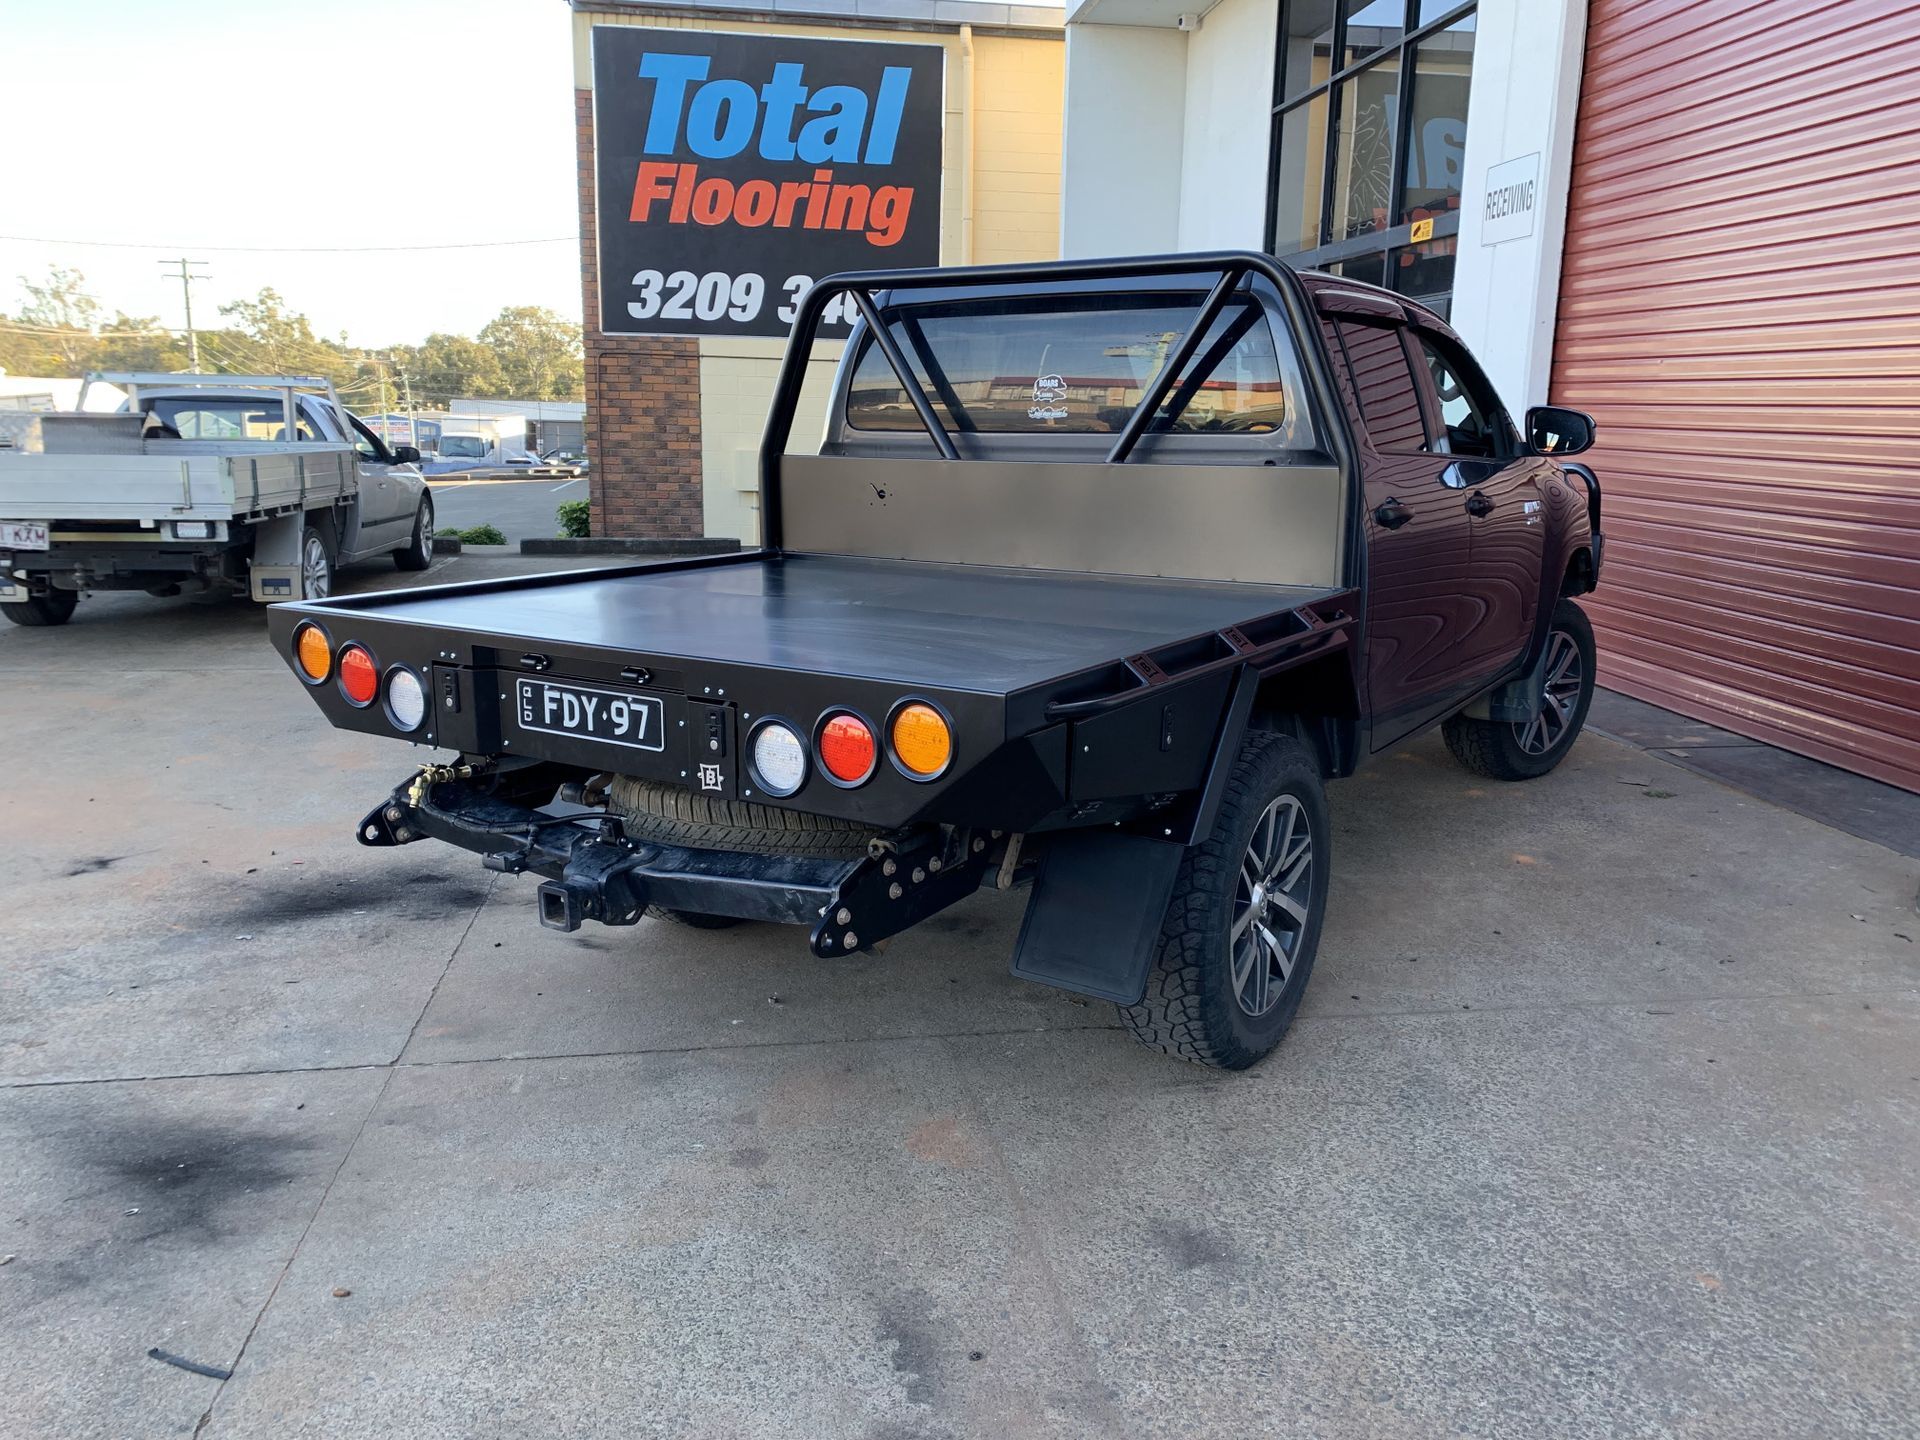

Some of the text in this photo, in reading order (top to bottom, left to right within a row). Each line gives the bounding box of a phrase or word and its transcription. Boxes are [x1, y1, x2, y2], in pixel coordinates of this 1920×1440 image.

[638, 52, 912, 165] Total
[629, 161, 914, 246] Flooring
[1485, 179, 1534, 221] RECEIVING
[627, 269, 765, 322] 3209
[522, 686, 533, 722] QLD
